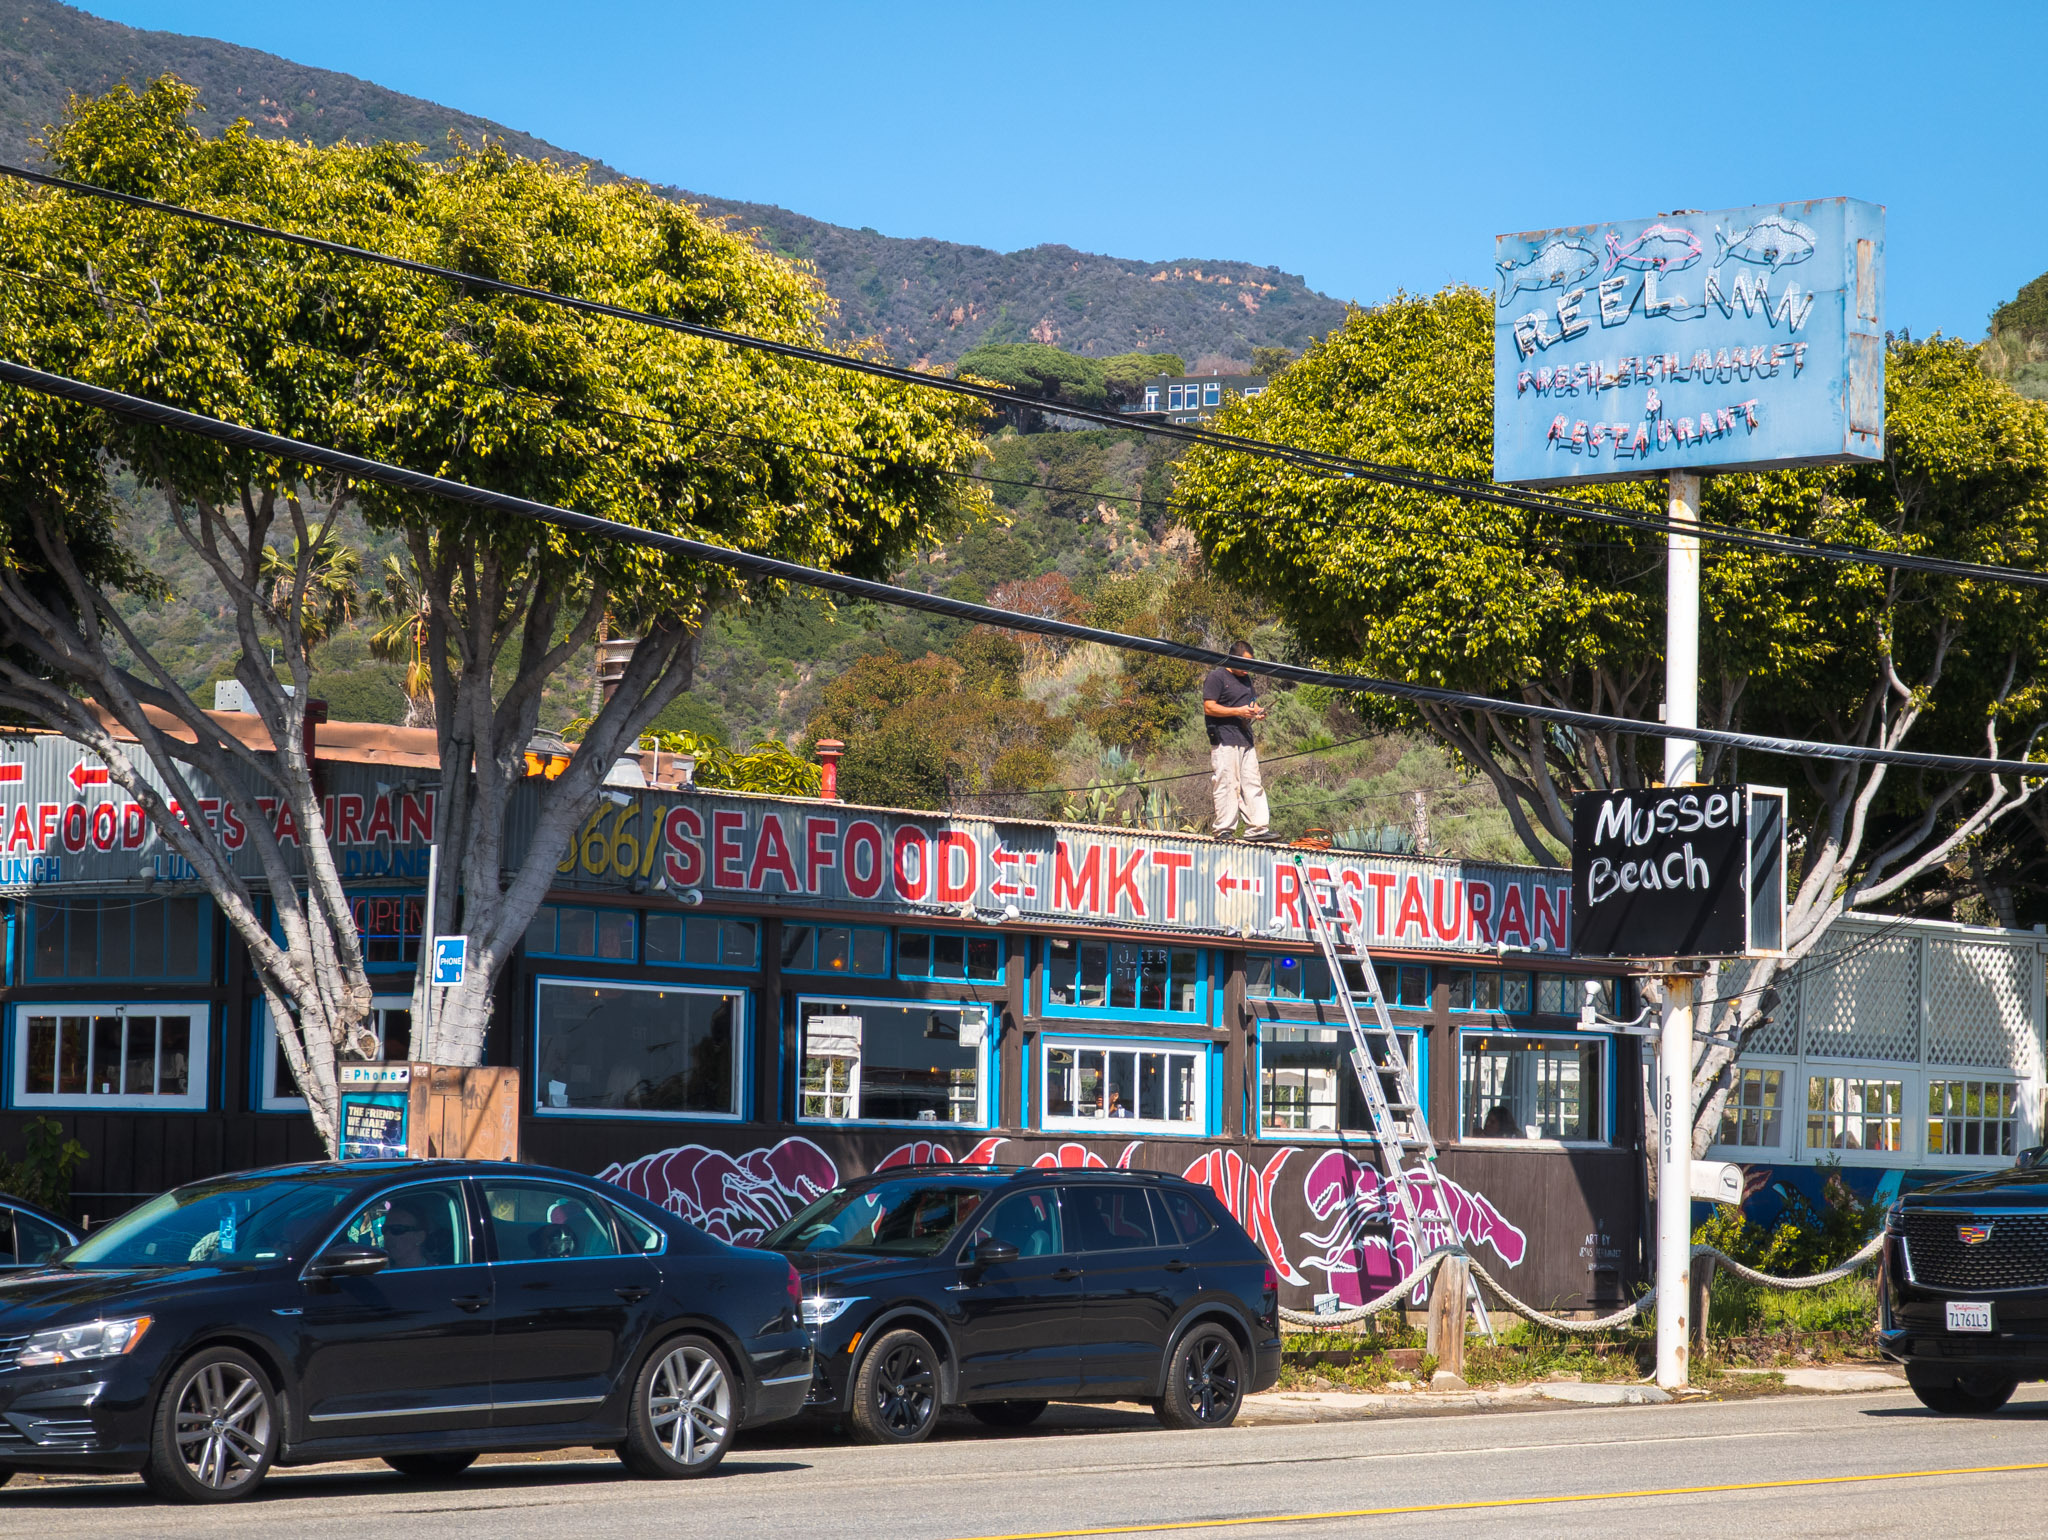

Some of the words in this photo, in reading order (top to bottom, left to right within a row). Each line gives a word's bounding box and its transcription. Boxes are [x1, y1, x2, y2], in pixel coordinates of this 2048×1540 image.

[1514, 271, 1674, 353] REEL
[1690, 342, 1808, 371] MARKET
[1646, 388, 1661, 411] &
[1547, 398, 1758, 452] RESTAURANT
[1594, 791, 1740, 847] Mussel
[664, 805, 981, 904] SEAFOOD
[1053, 839, 1193, 922] MKT
[1272, 861, 1573, 952] RESTAURAN
[1588, 842, 1710, 906] Beach
[354, 899, 423, 933] OPEN
[440, 957, 463, 965] PHONE
[354, 1069, 397, 1080] Phone
[347, 1116, 360, 1126] WE
[348, 1106, 364, 1117] THE
[365, 1107, 402, 1121] FRIENDS
[1664, 1075, 1672, 1163] 18661
[346, 1126, 371, 1137] MAKE
[1585, 1233, 1599, 1246] ART
[1949, 1312, 1989, 1327] 71761L3
